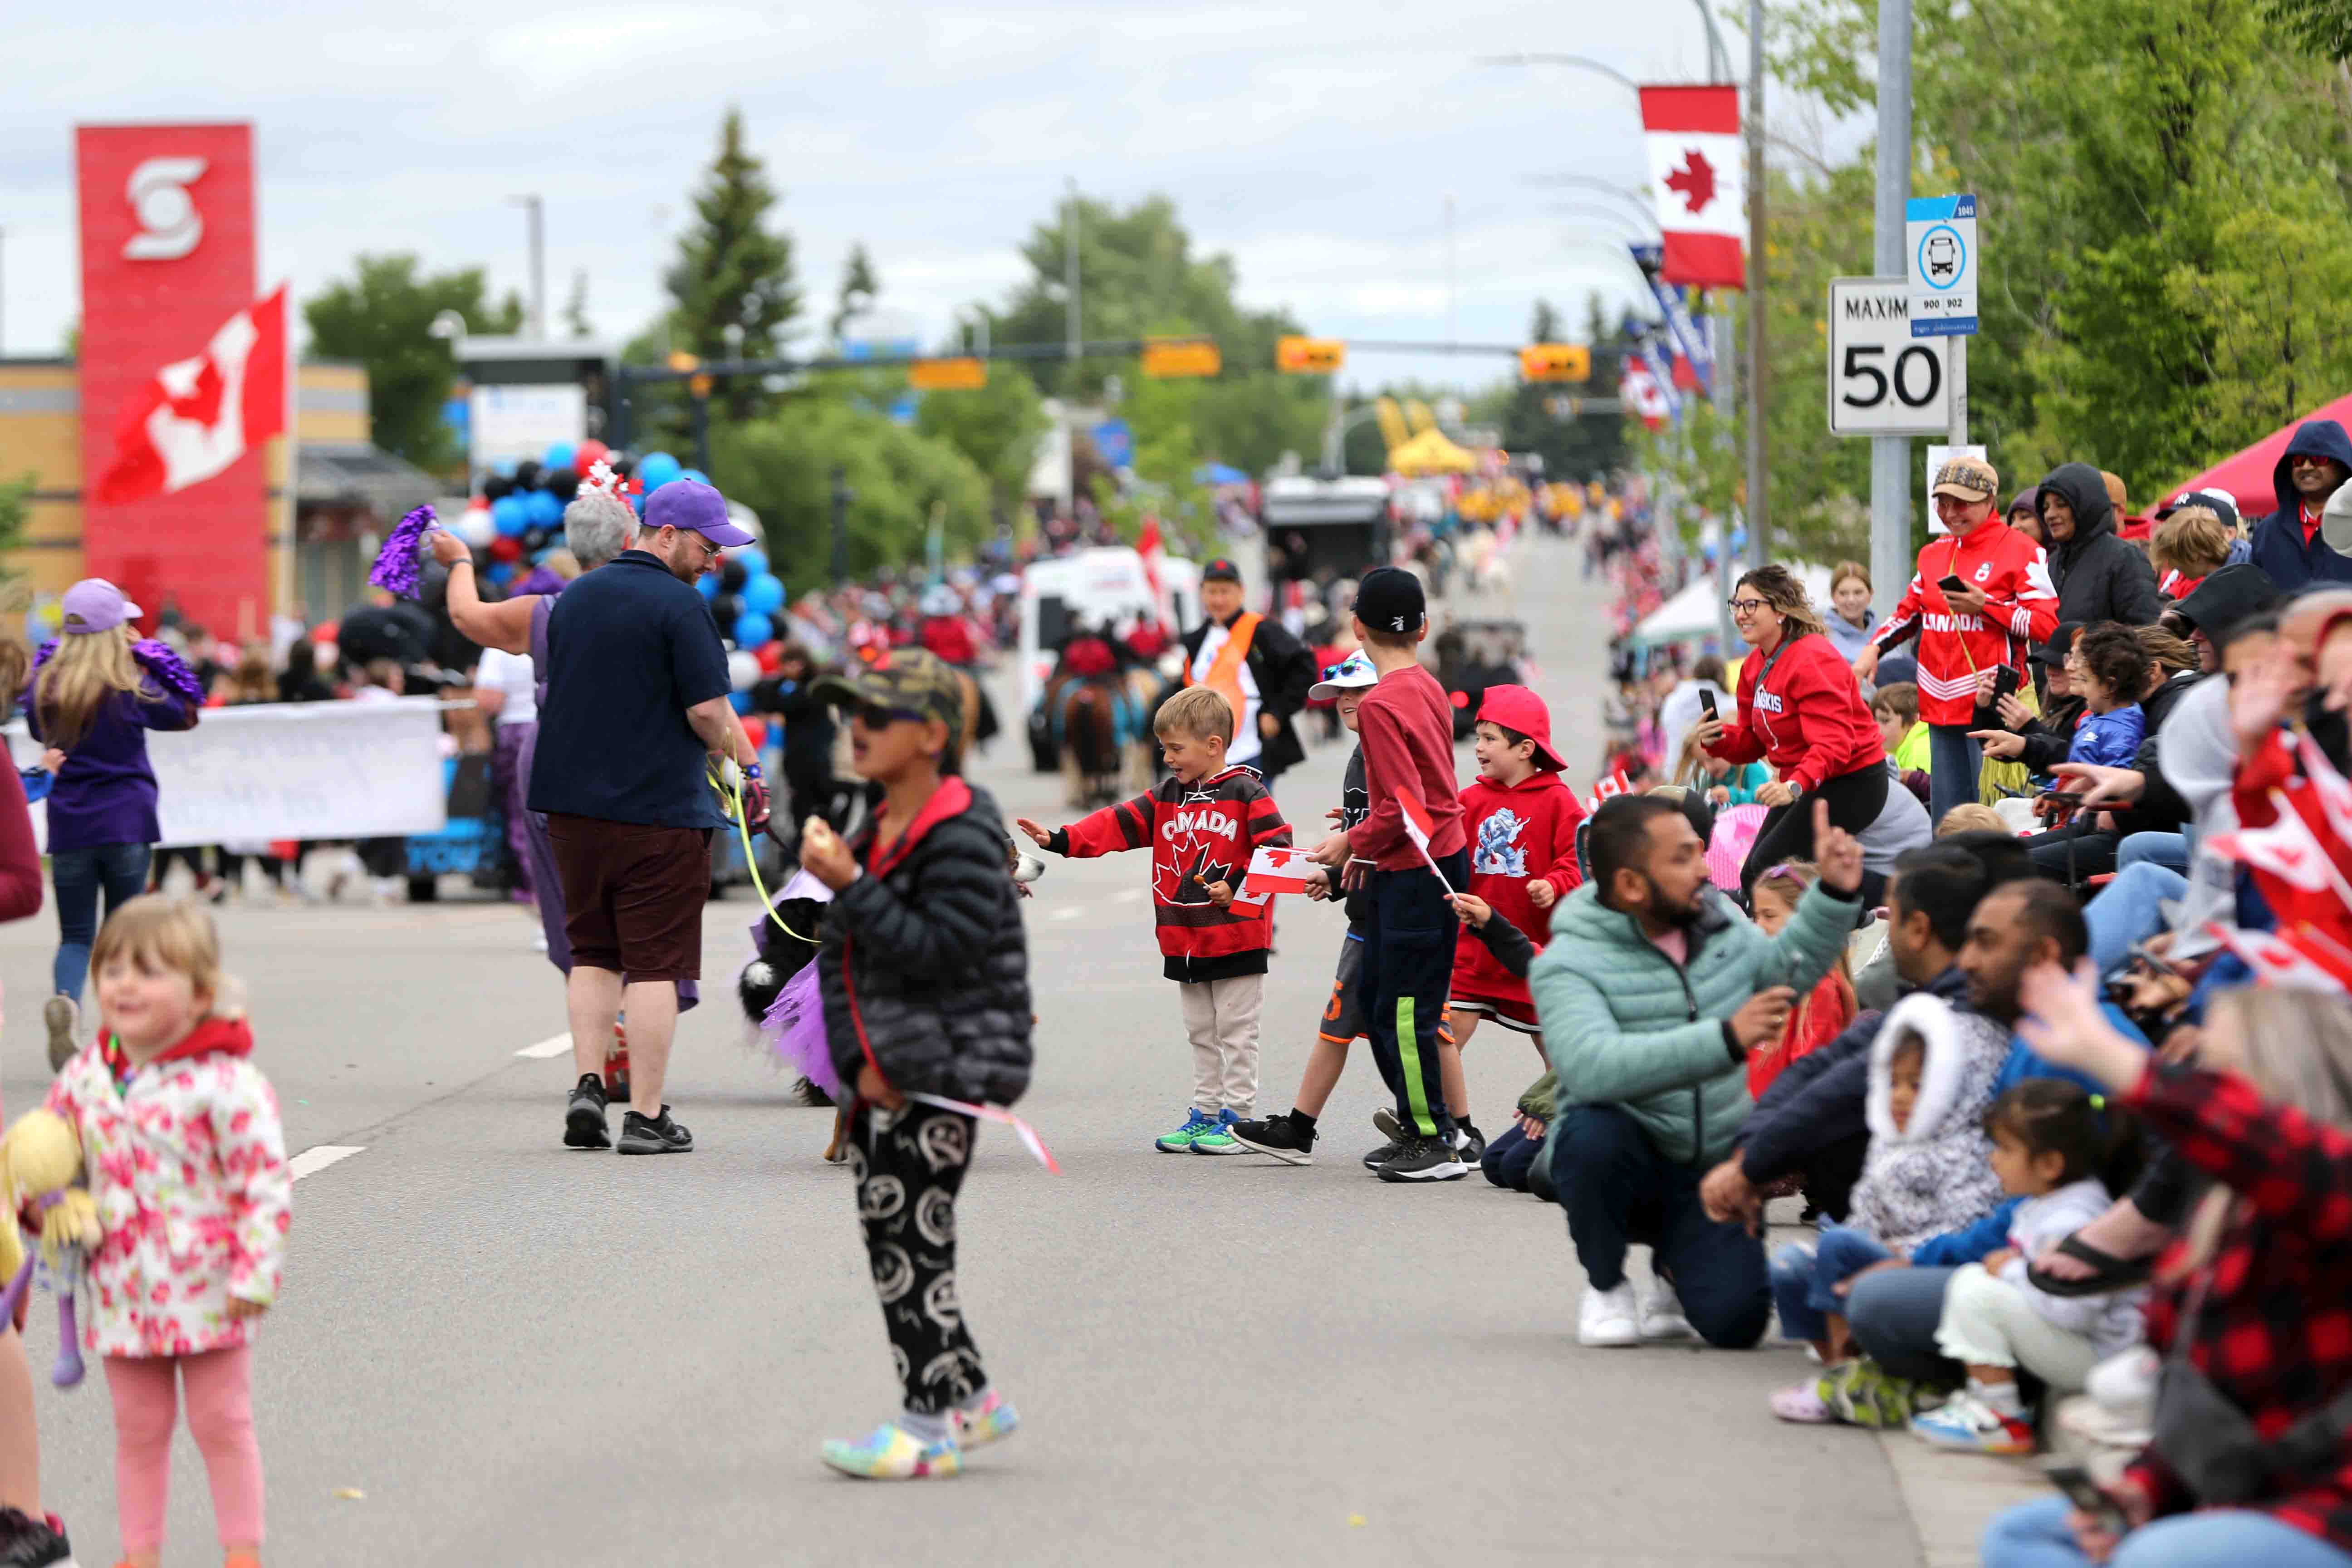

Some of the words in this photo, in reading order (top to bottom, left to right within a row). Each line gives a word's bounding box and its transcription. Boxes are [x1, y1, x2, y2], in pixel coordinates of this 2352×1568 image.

[1845, 296, 1908, 319] MAXIM
[1924, 299, 1940, 309] 900
[1947, 298, 1963, 308] 902
[1843, 345, 1941, 407] 50
[1161, 810, 1238, 843] CANADA
